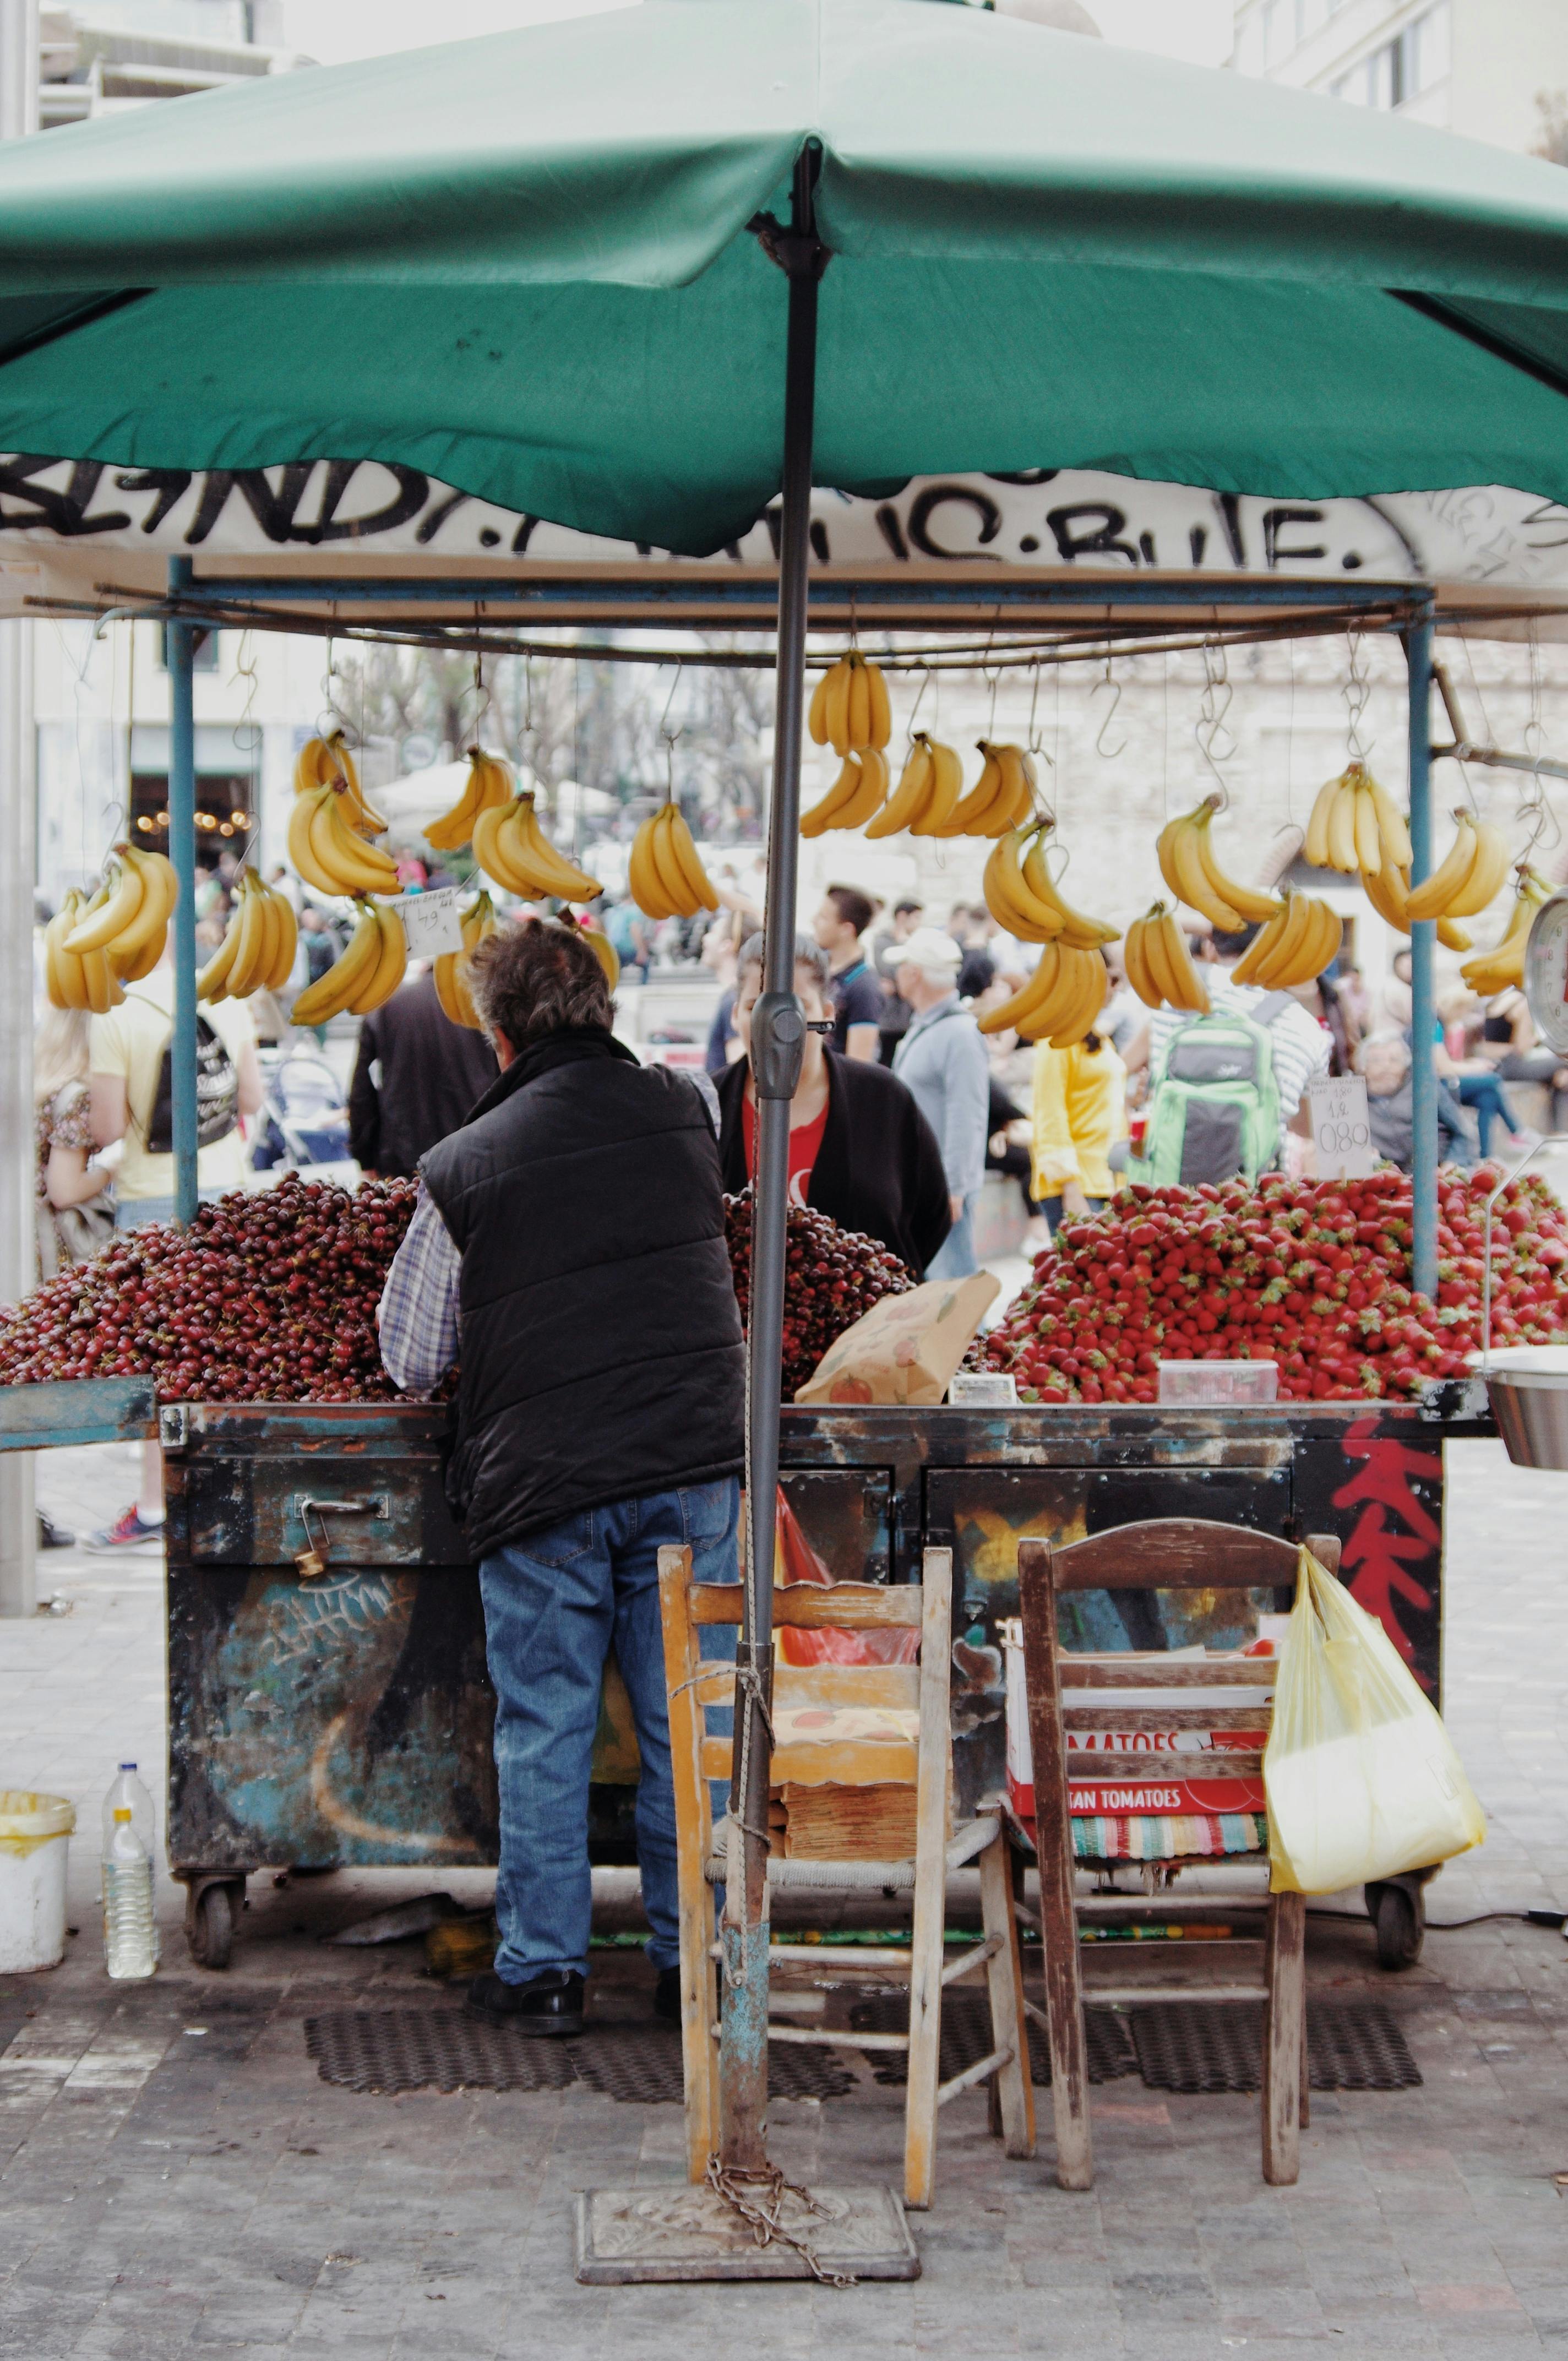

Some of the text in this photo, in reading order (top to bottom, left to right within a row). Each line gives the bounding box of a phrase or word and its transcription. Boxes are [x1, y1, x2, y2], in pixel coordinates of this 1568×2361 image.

[1548, 949, 1553, 961] 8
[1547, 982, 1553, 993] 7
[1068, 1732, 1179, 1751] MATOES
[1069, 1788, 1181, 1809] TAN TOMATOES
